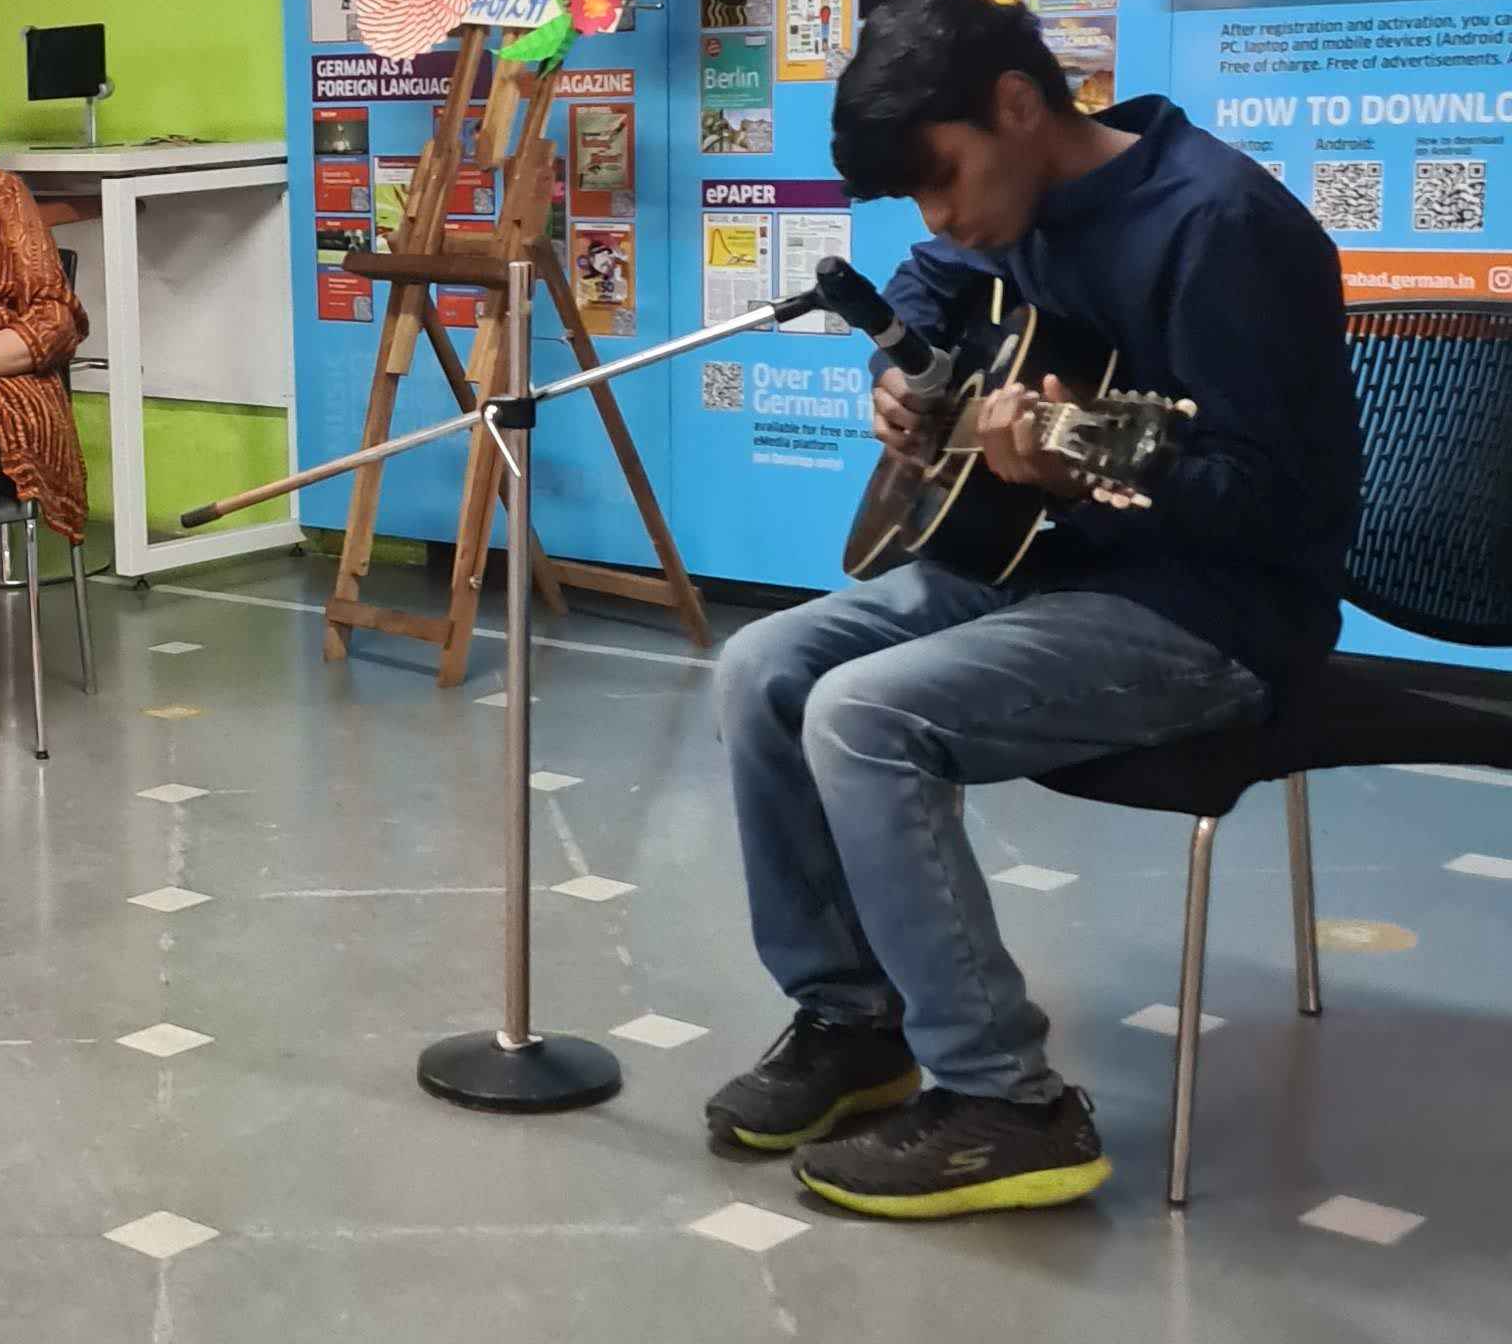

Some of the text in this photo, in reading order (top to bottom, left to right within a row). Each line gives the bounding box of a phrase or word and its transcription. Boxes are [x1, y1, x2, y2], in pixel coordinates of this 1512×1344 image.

[1259, 20, 1344, 37] registration
[1347, 18, 1374, 32] and
[1461, 15, 1490, 29] you
[1292, 38, 1319, 51] and
[1322, 35, 1372, 50] mobile
[1376, 33, 1432, 48] devices
[316, 58, 414, 77] GERMAN AS A
[1220, 60, 1250, 73] Free
[1254, 59, 1267, 72] of
[1326, 57, 1359, 71] Free
[1362, 55, 1377, 69] of
[317, 78, 377, 97] FOREIGN
[704, 65, 760, 89] Berlin
[1215, 96, 1298, 128] HOW
[1306, 96, 1351, 126] TO
[705, 183, 777, 205] ePAPER
[753, 362, 862, 393] Over 150
[753, 388, 849, 420] German
